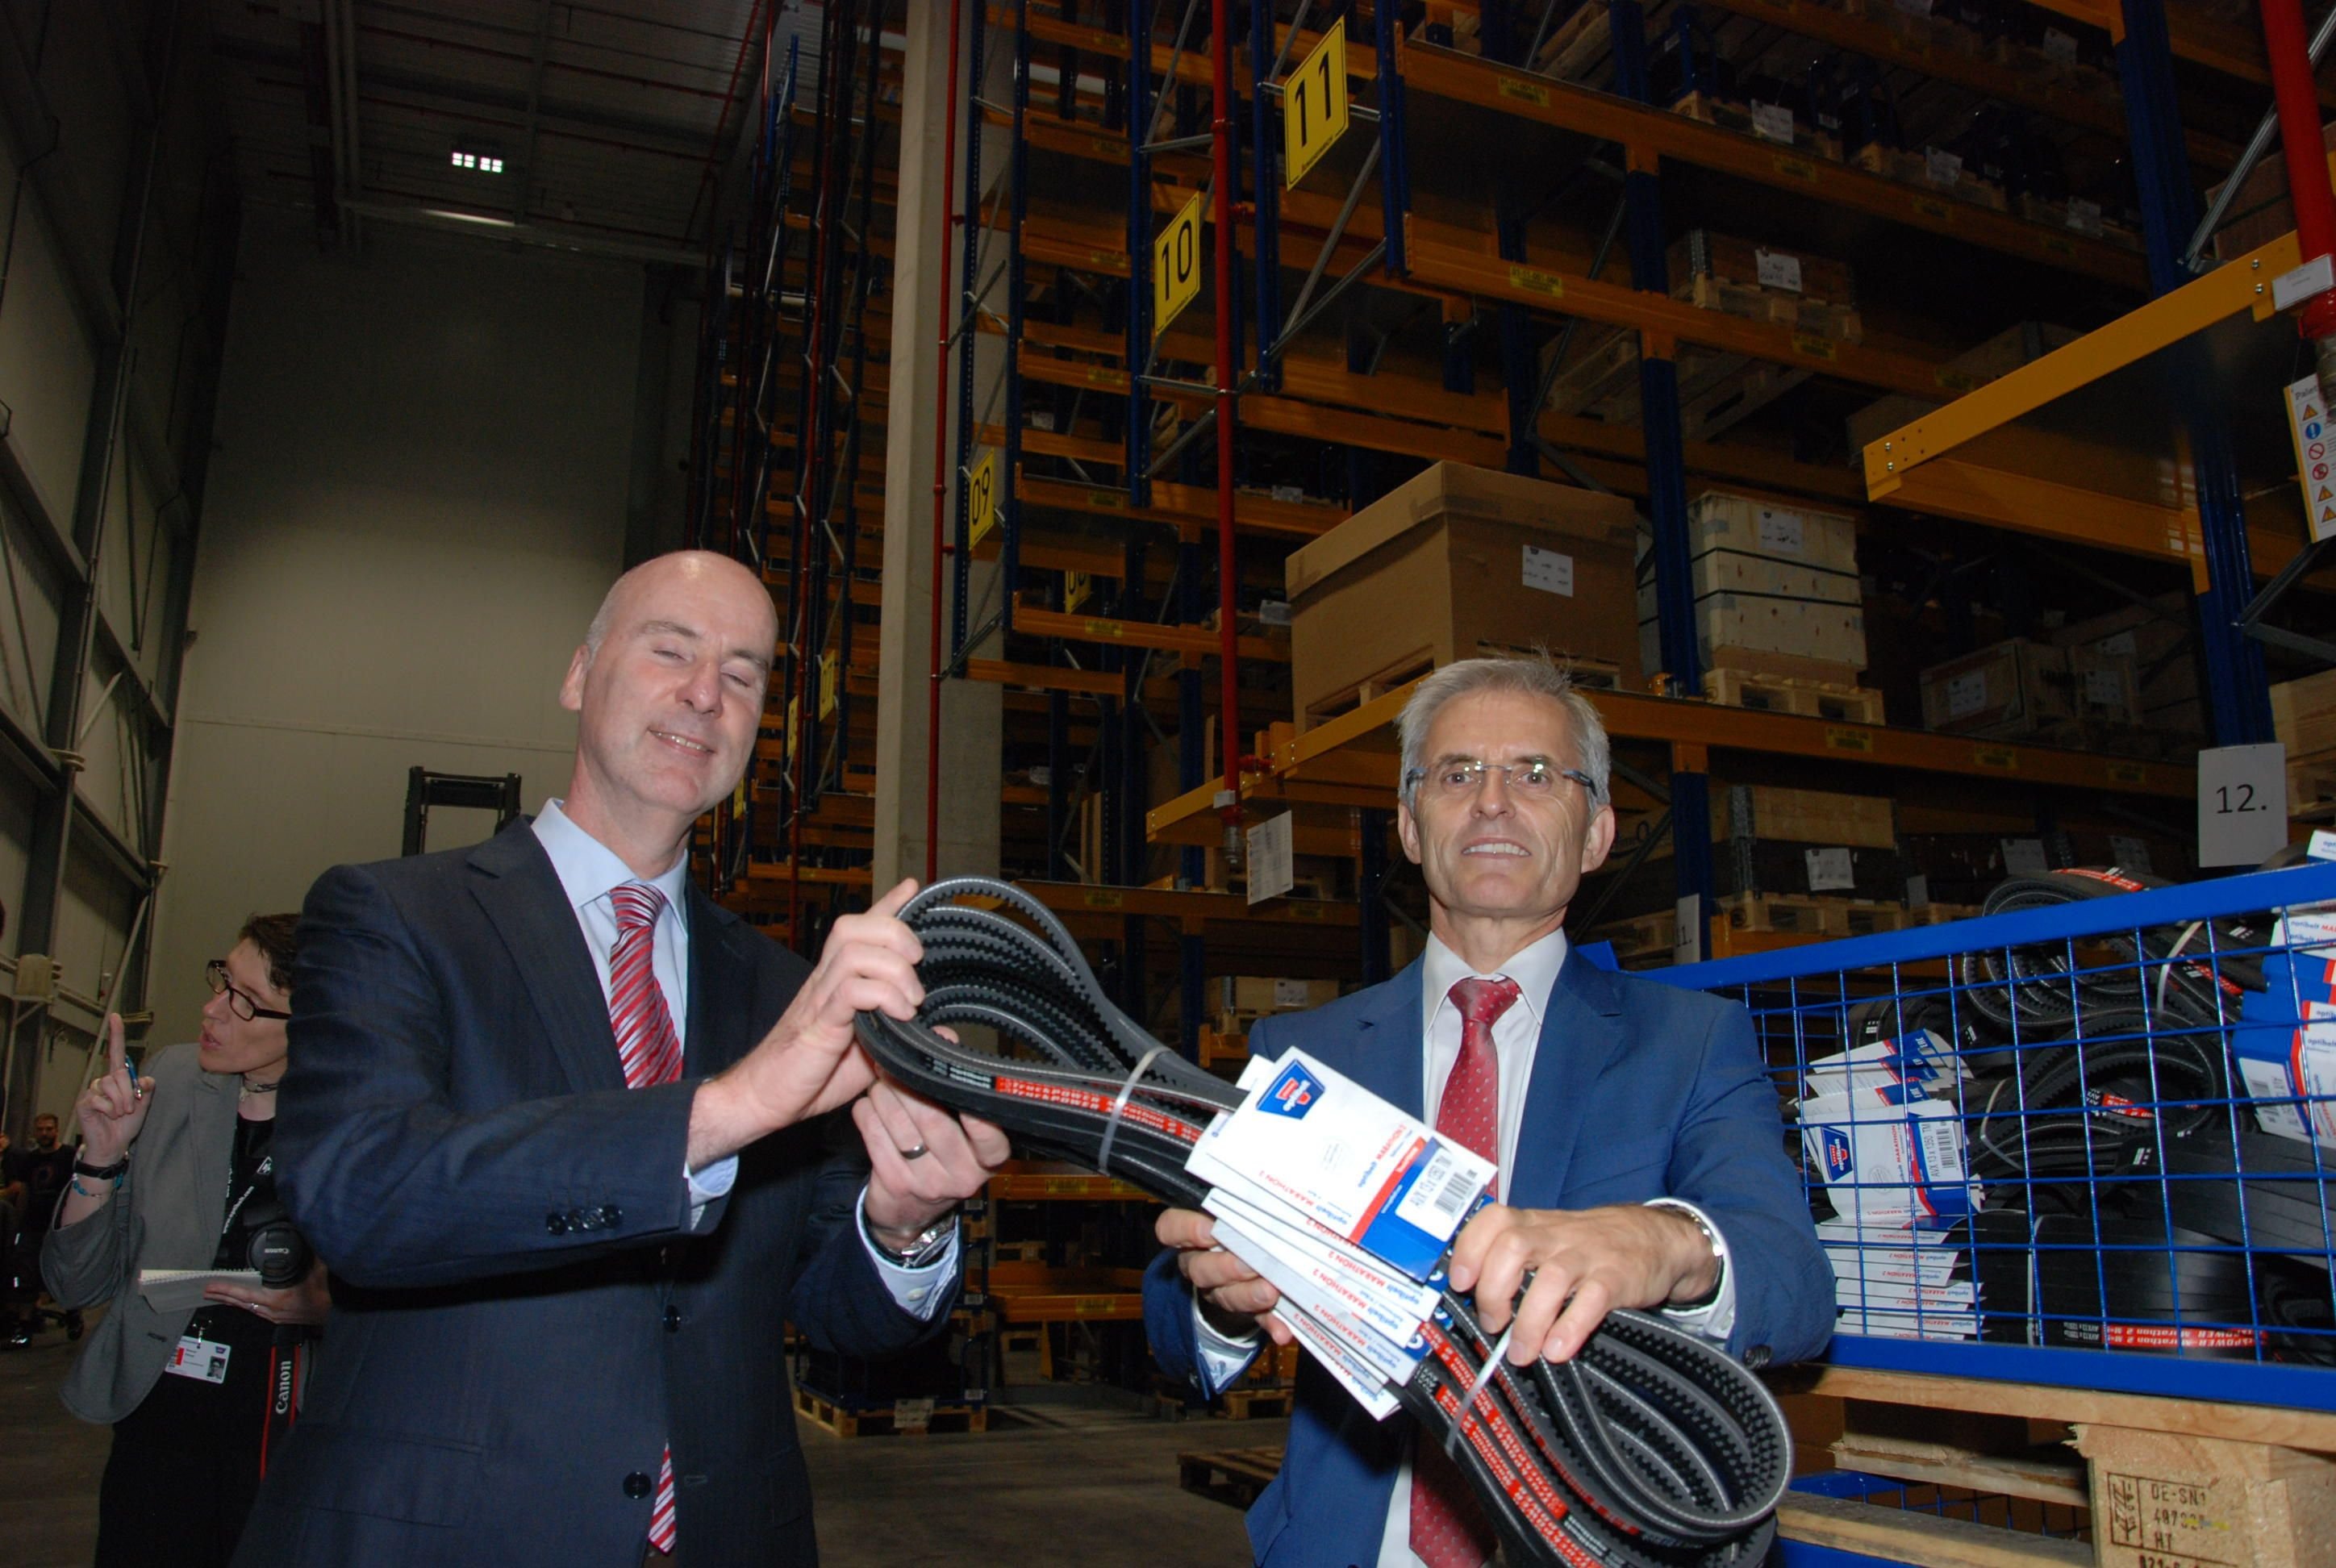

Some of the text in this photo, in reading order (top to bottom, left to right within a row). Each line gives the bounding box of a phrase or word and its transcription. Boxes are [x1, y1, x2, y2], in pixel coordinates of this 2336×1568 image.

[1294, 48, 1333, 150] 11
[1160, 219, 1193, 302] 10
[971, 465, 991, 526] 09
[2216, 783, 2267, 815] 12.
[1106, 1099, 1165, 1124] Mrathon
[1106, 1106, 1163, 1130] Mrathon
[1333, 1253, 1386, 1288] MARATHON
[1317, 1271, 1367, 1309] MARATHON
[1385, 1282, 1420, 1307] optibelt
[1318, 1307, 1366, 1347] MARATHON
[1366, 1305, 1400, 1330] optibelt
[1298, 1316, 1342, 1356] MARATHON
[1365, 1343, 1398, 1370] optibelt
[276, 1361, 291, 1415] Canon
[2155, 1532, 2172, 1550] HT
